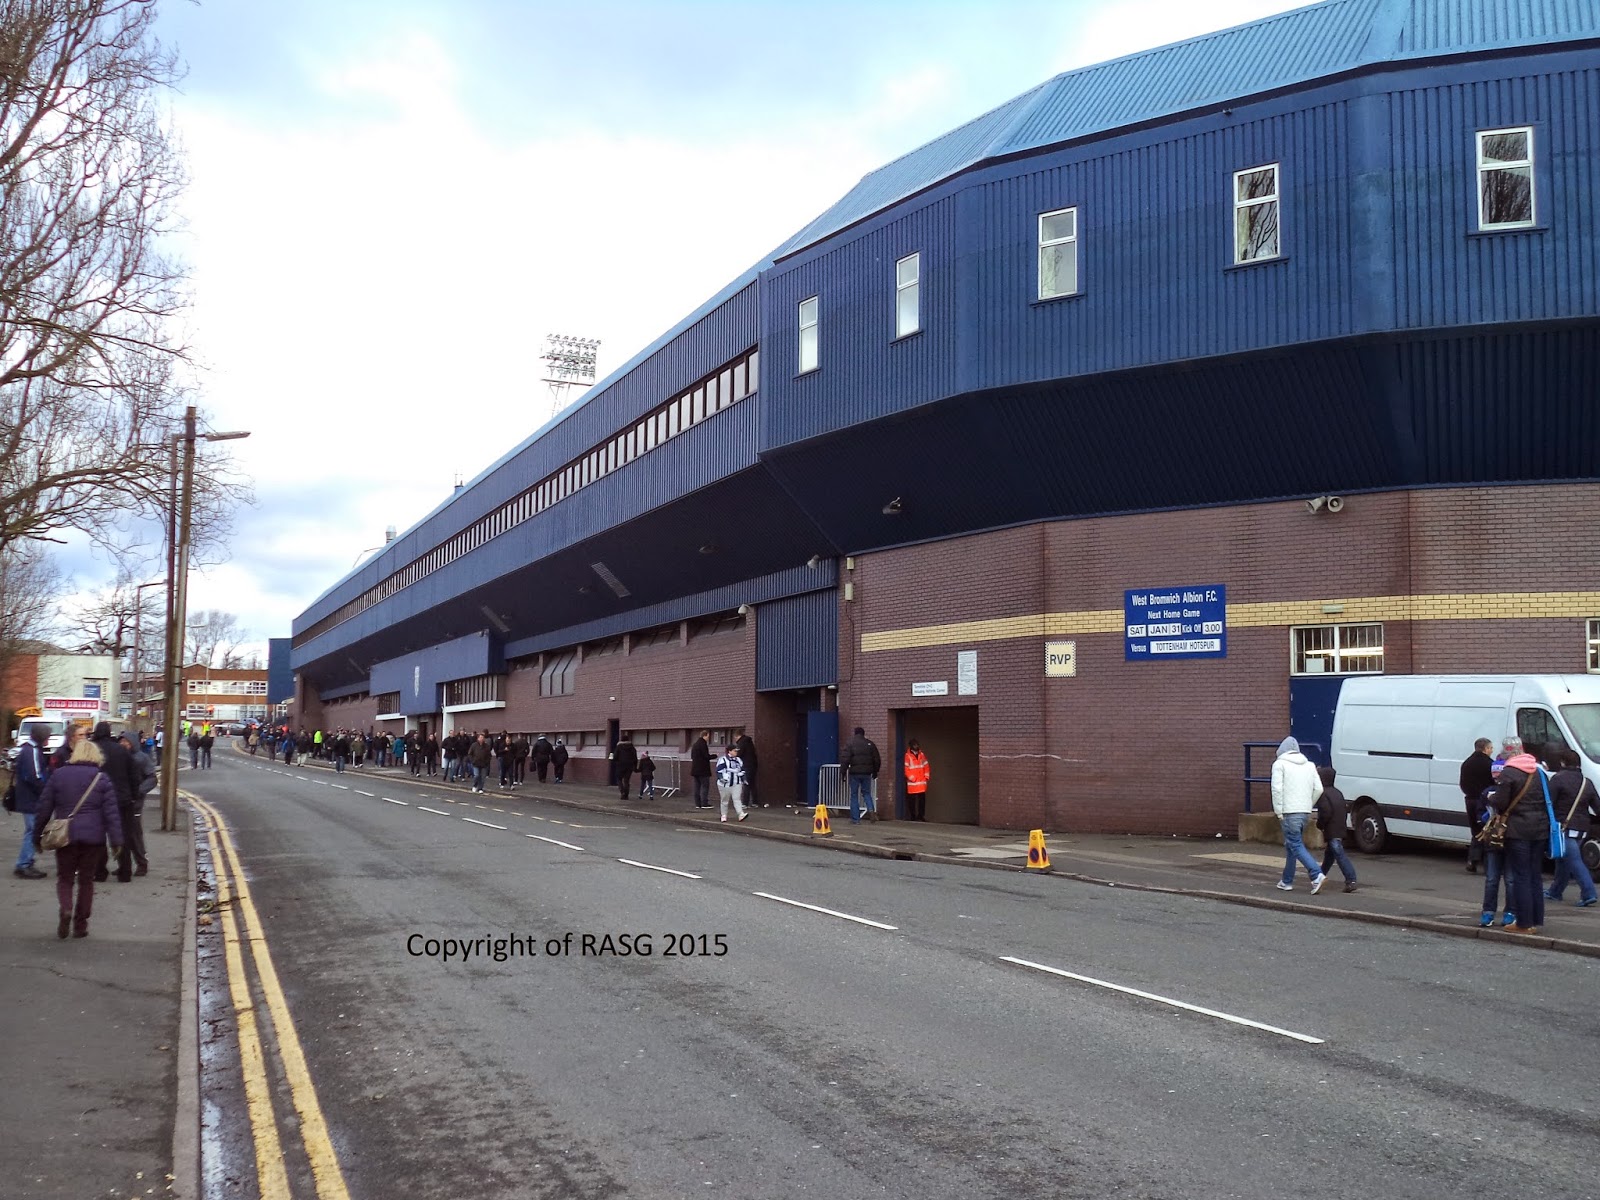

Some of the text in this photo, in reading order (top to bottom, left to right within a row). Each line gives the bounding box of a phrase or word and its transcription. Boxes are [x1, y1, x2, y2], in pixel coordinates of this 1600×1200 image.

[1132, 590, 1217, 606] West Bromwich Albion F.C.
[1148, 609, 1200, 619] Next Home Game
[1130, 627, 1144, 635] SAT
[1150, 625, 1168, 634] JAN
[1171, 624, 1180, 633] 31
[1182, 625, 1192, 633] Kick
[1131, 641, 1214, 652] Versus TOTTENHAM HOTSPUR
[1049, 653, 1072, 665] RVP
